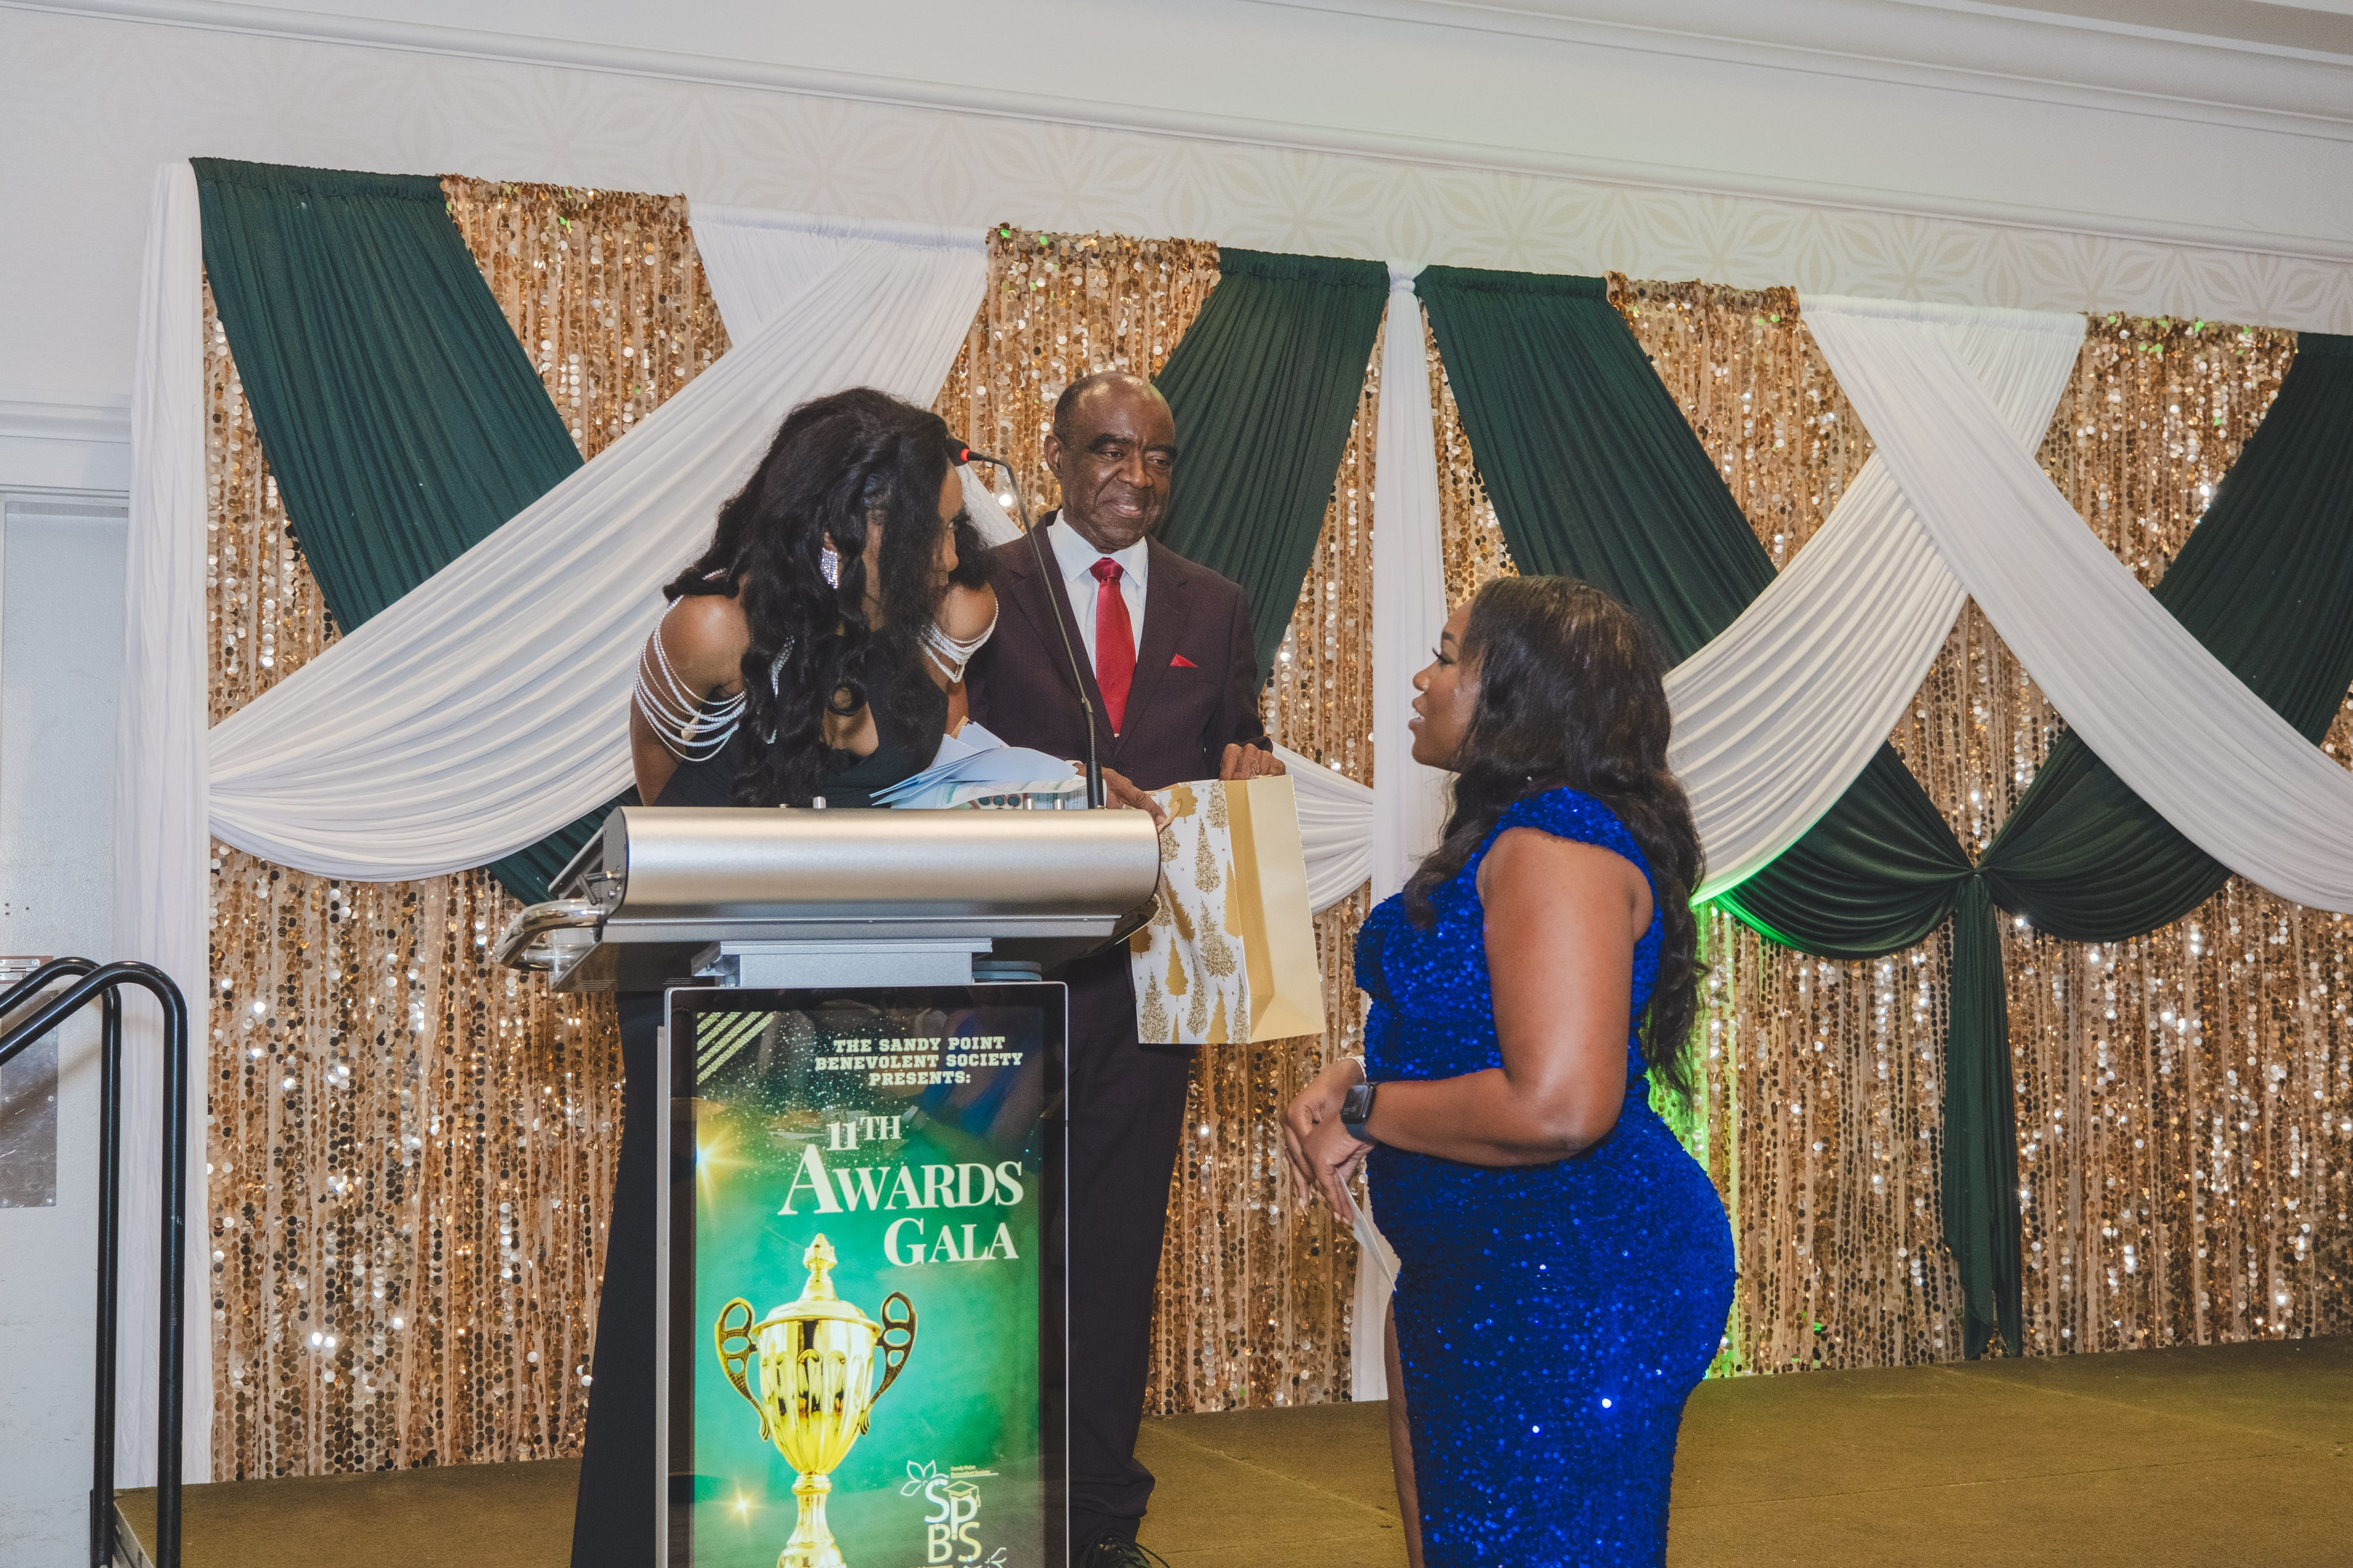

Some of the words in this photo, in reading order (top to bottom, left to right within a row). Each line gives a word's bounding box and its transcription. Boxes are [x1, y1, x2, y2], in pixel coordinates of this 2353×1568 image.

[833, 1039, 872, 1053] THE
[879, 1037, 941, 1052] SANDY
[948, 1036, 1005, 1051] POINT
[815, 1055, 939, 1071] BENEVOLENT
[946, 1052, 1023, 1067] SOCIETY
[869, 1071, 971, 1086] PRESENTS:
[826, 1115, 901, 1151] 11TH
[777, 1144, 1024, 1215] AWARDS
[884, 1217, 1019, 1267] GALA
